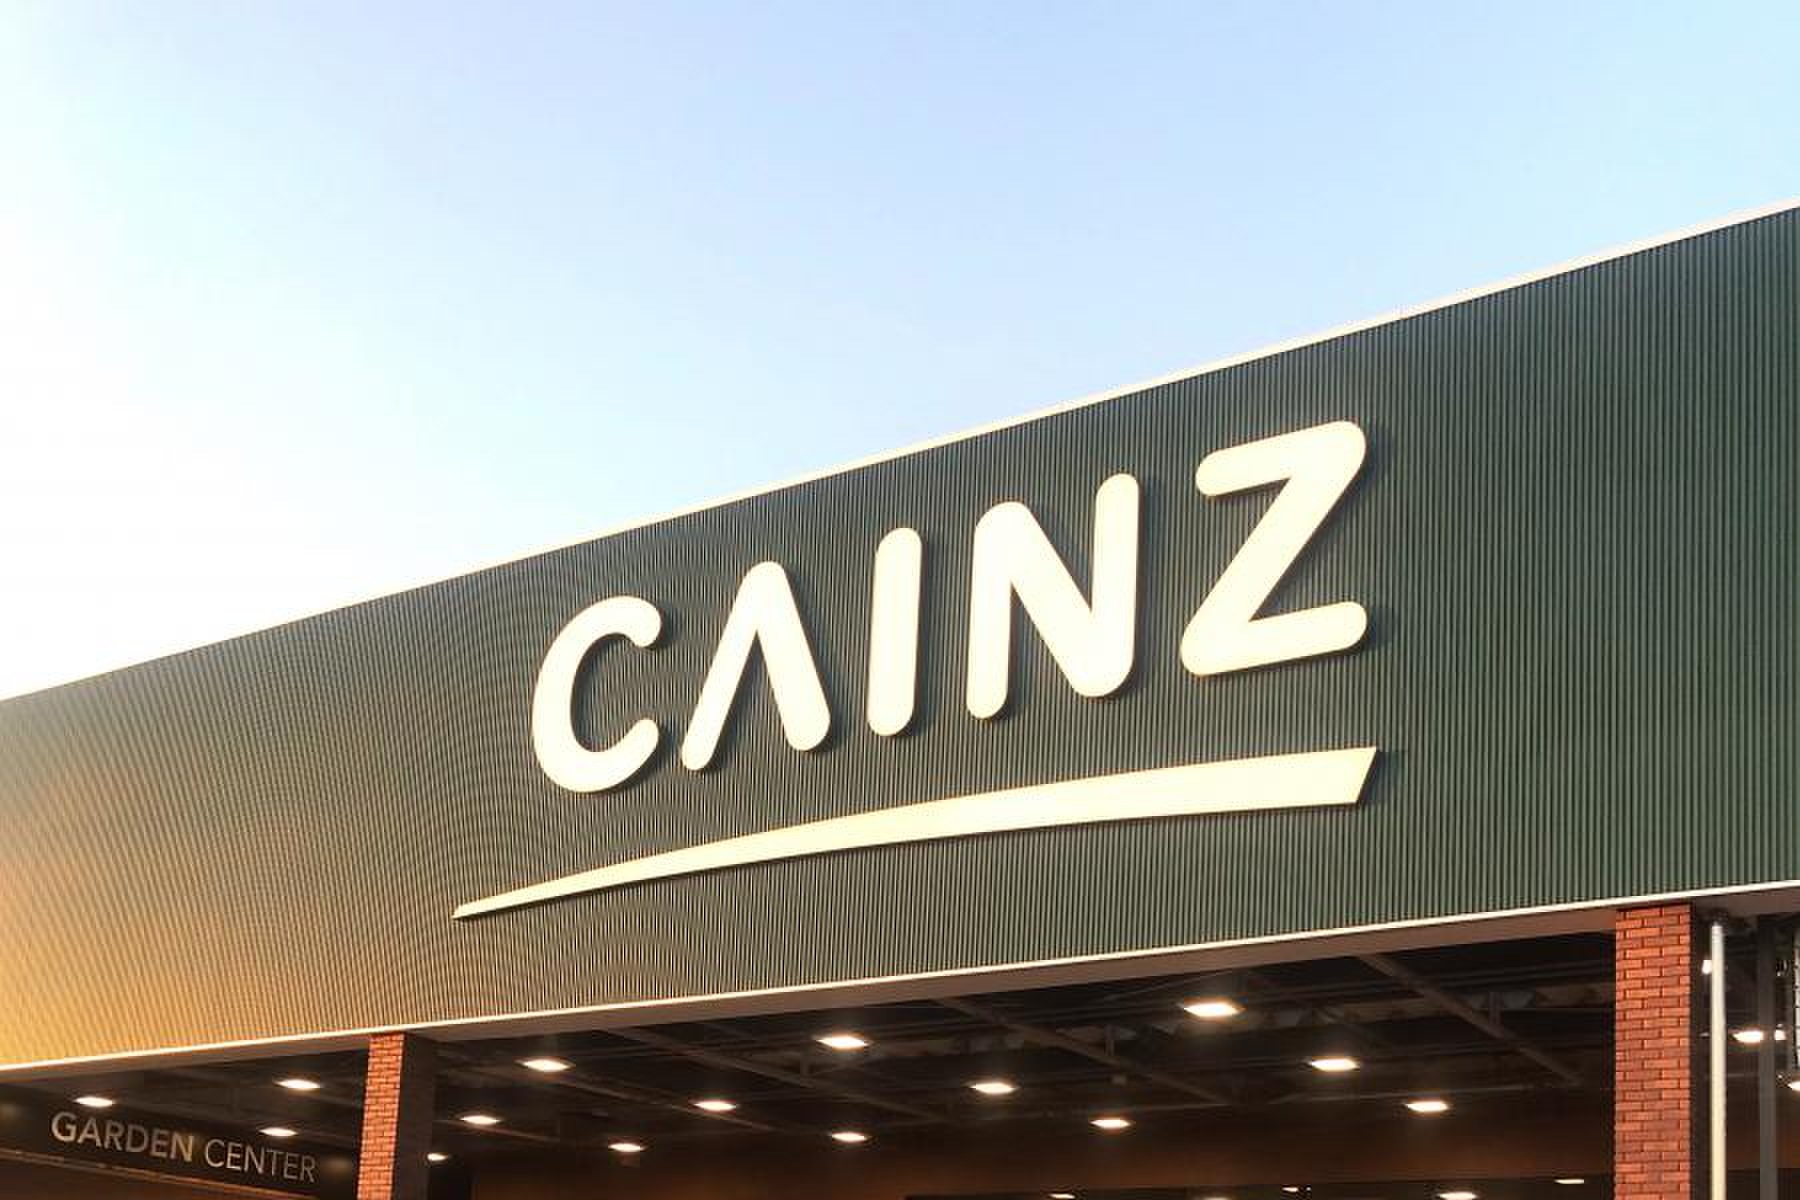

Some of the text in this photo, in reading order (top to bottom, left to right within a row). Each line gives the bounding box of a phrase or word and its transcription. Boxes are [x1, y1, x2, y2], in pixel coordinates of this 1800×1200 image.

[531, 419, 1368, 793] CAINZ
[51, 1111, 318, 1183] GARDEN CENTER
